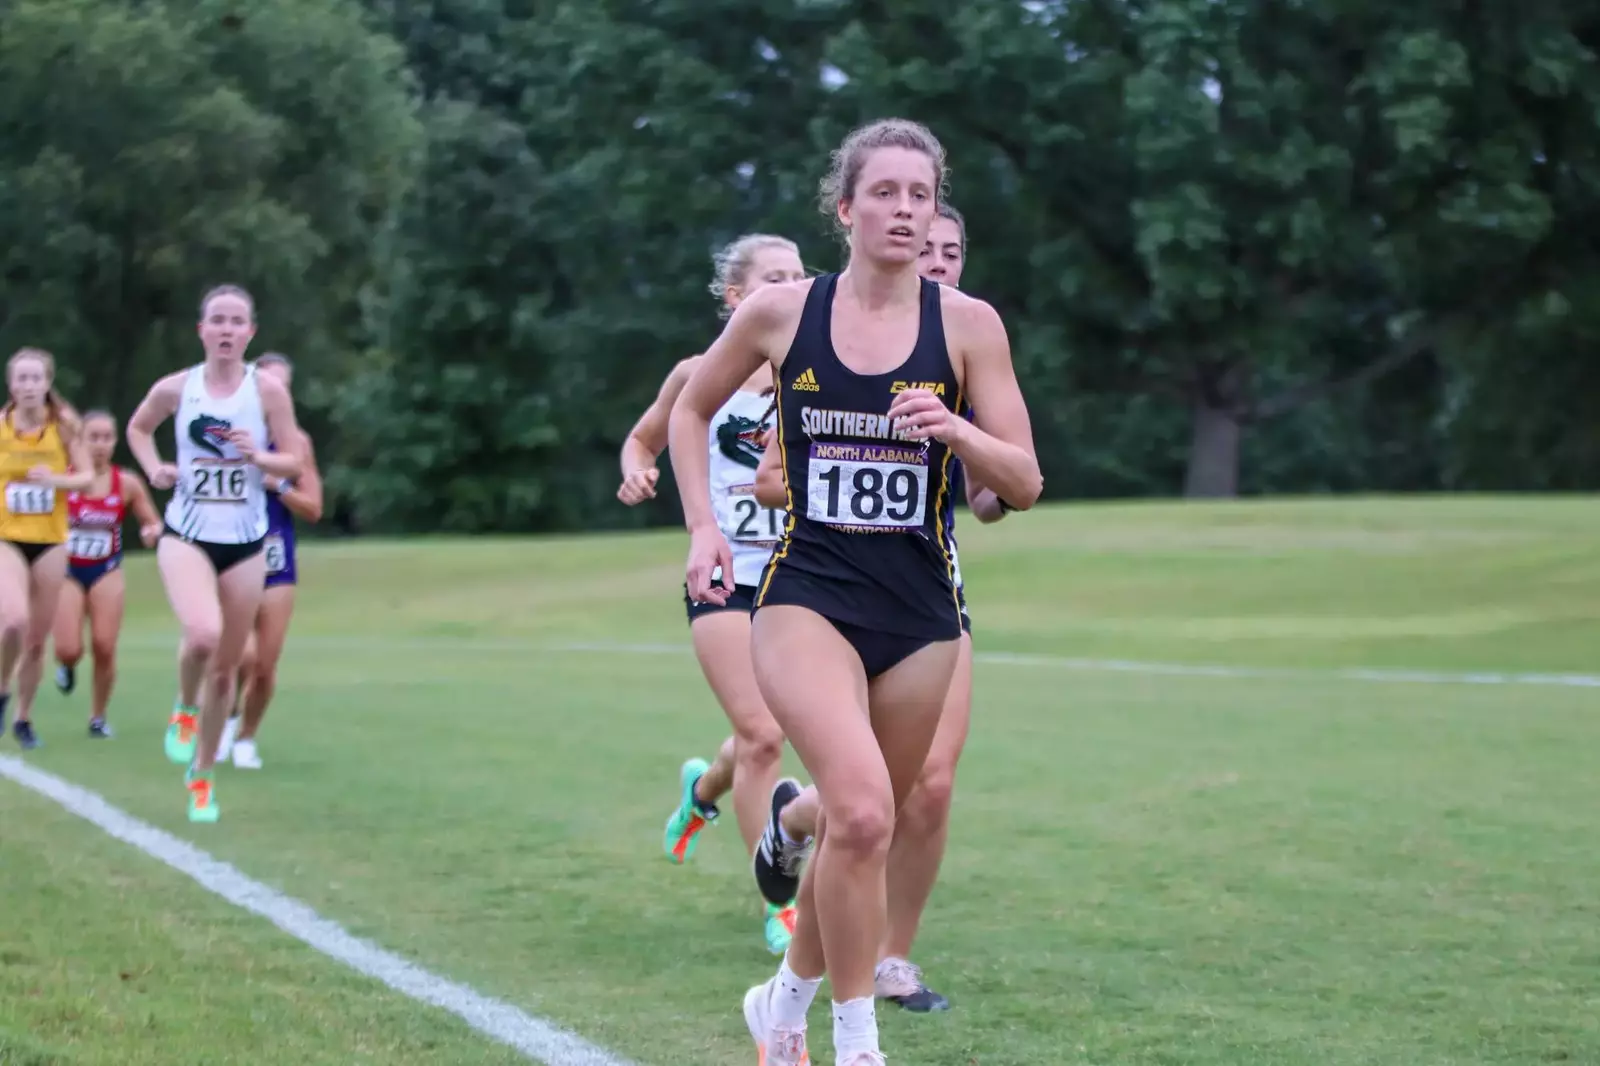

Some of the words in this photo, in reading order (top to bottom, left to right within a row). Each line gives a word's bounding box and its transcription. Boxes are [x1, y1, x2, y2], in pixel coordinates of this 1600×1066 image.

[792, 382, 820, 392] adidas
[801, 406, 890, 439] SOUTHERN
[817, 446, 860, 461] NORTH
[863, 448, 924, 465] ALABAMA
[193, 468, 247, 498] 216
[818, 465, 919, 521] 189
[12, 489, 50, 513] 111
